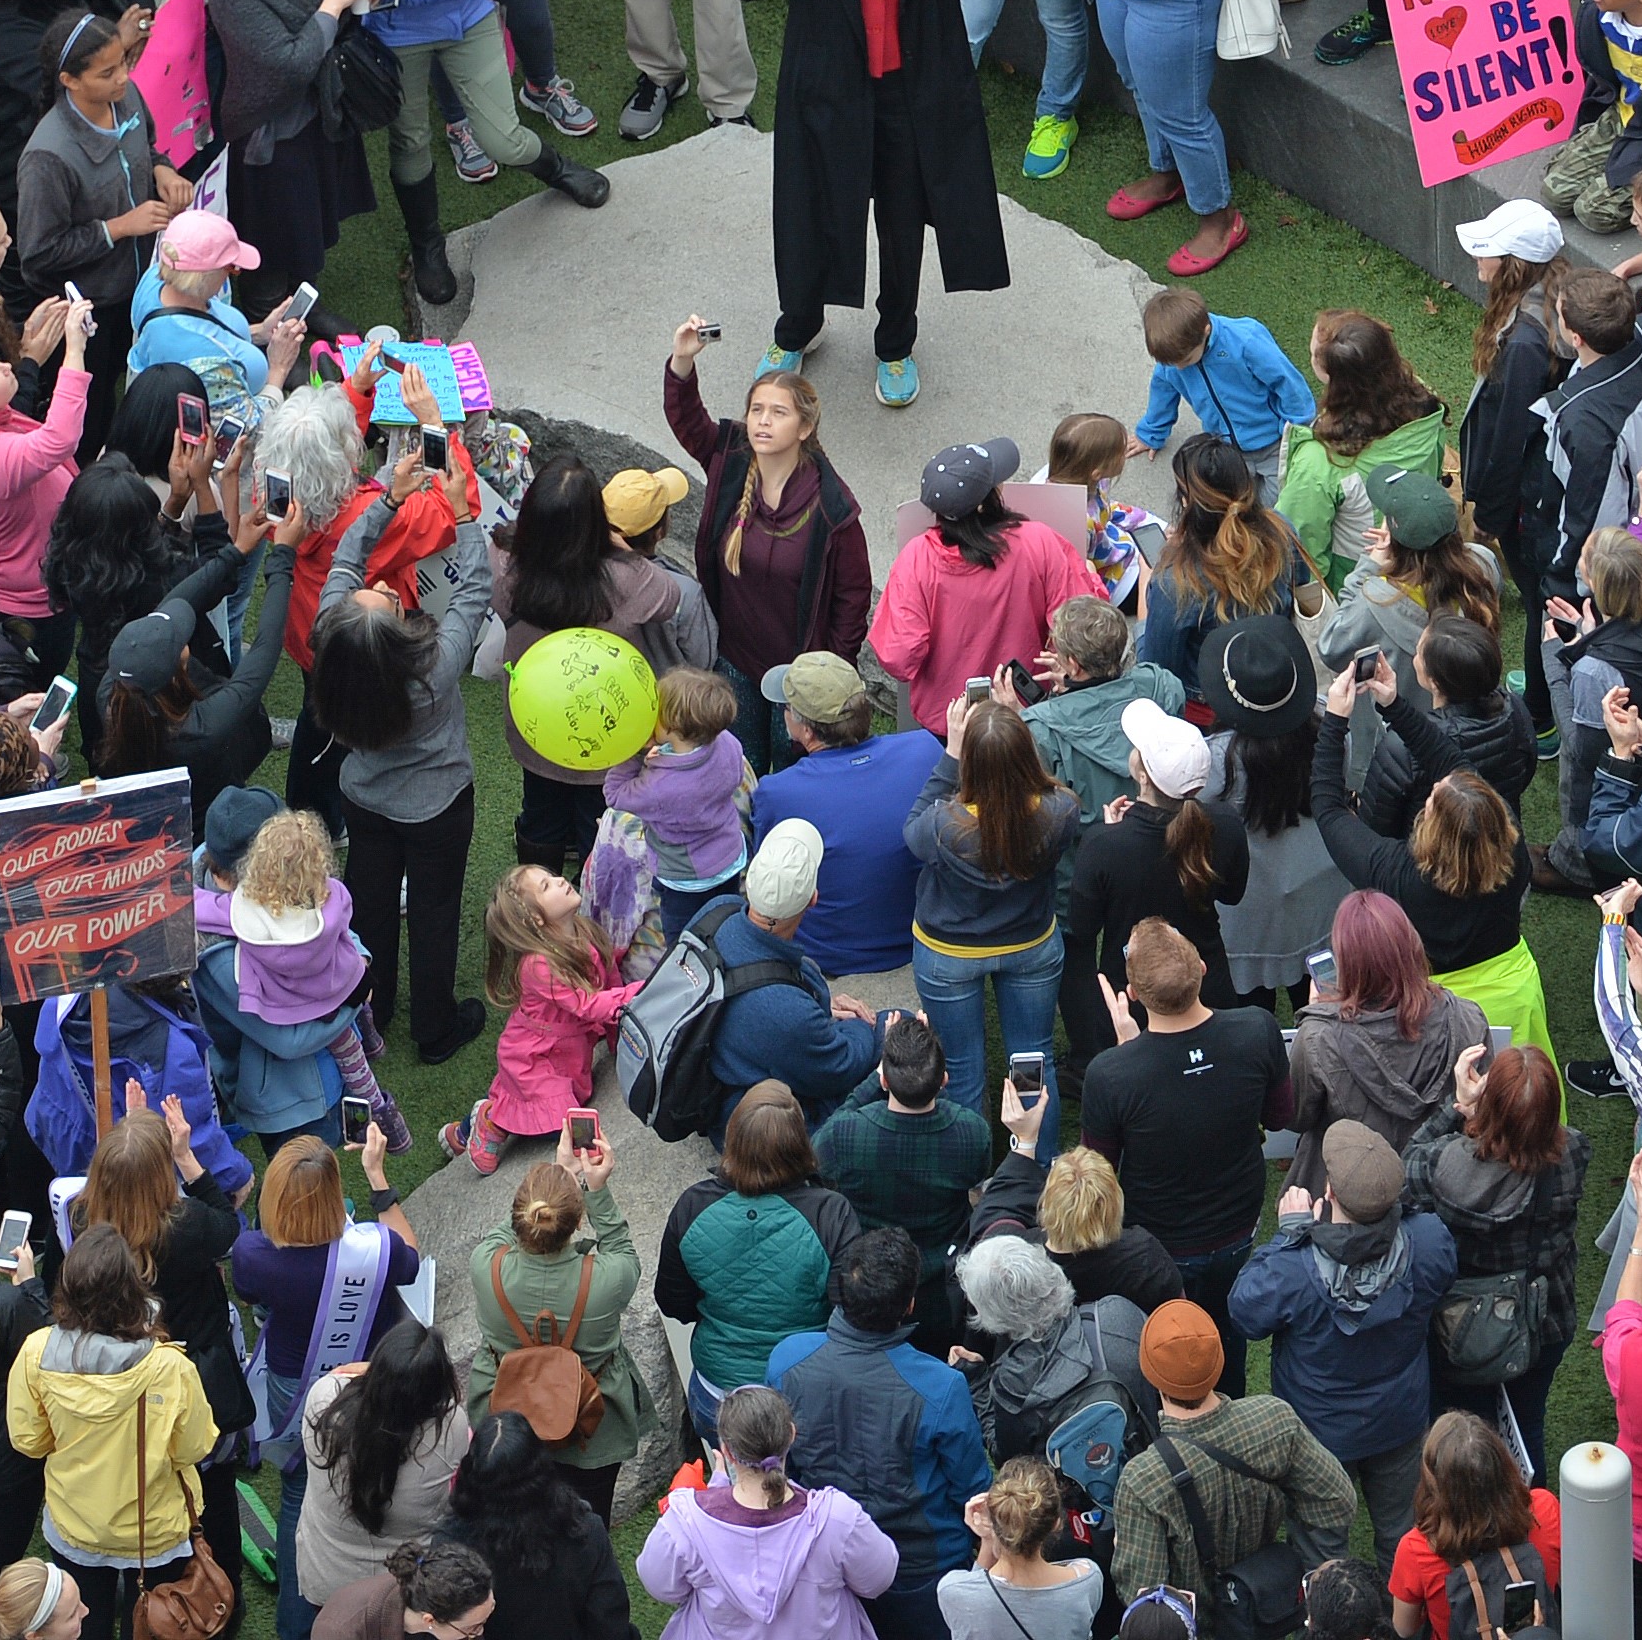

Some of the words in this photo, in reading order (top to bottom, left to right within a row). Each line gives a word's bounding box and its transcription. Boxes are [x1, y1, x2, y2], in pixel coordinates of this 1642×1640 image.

[1413, 14, 1575, 123] SILENT!
[1467, 122, 1508, 161] HUMAN
[1508, 99, 1551, 139] RIGHTS
[3, 849, 50, 878] OUR
[54, 820, 123, 859] BODIES
[45, 874, 94, 898] OUR
[103, 849, 168, 887] MINDS
[14, 925, 79, 955] OUR
[86, 892, 167, 945] POWER
[335, 1275, 366, 1324] LOVE
[328, 1333, 350, 1351] IS
